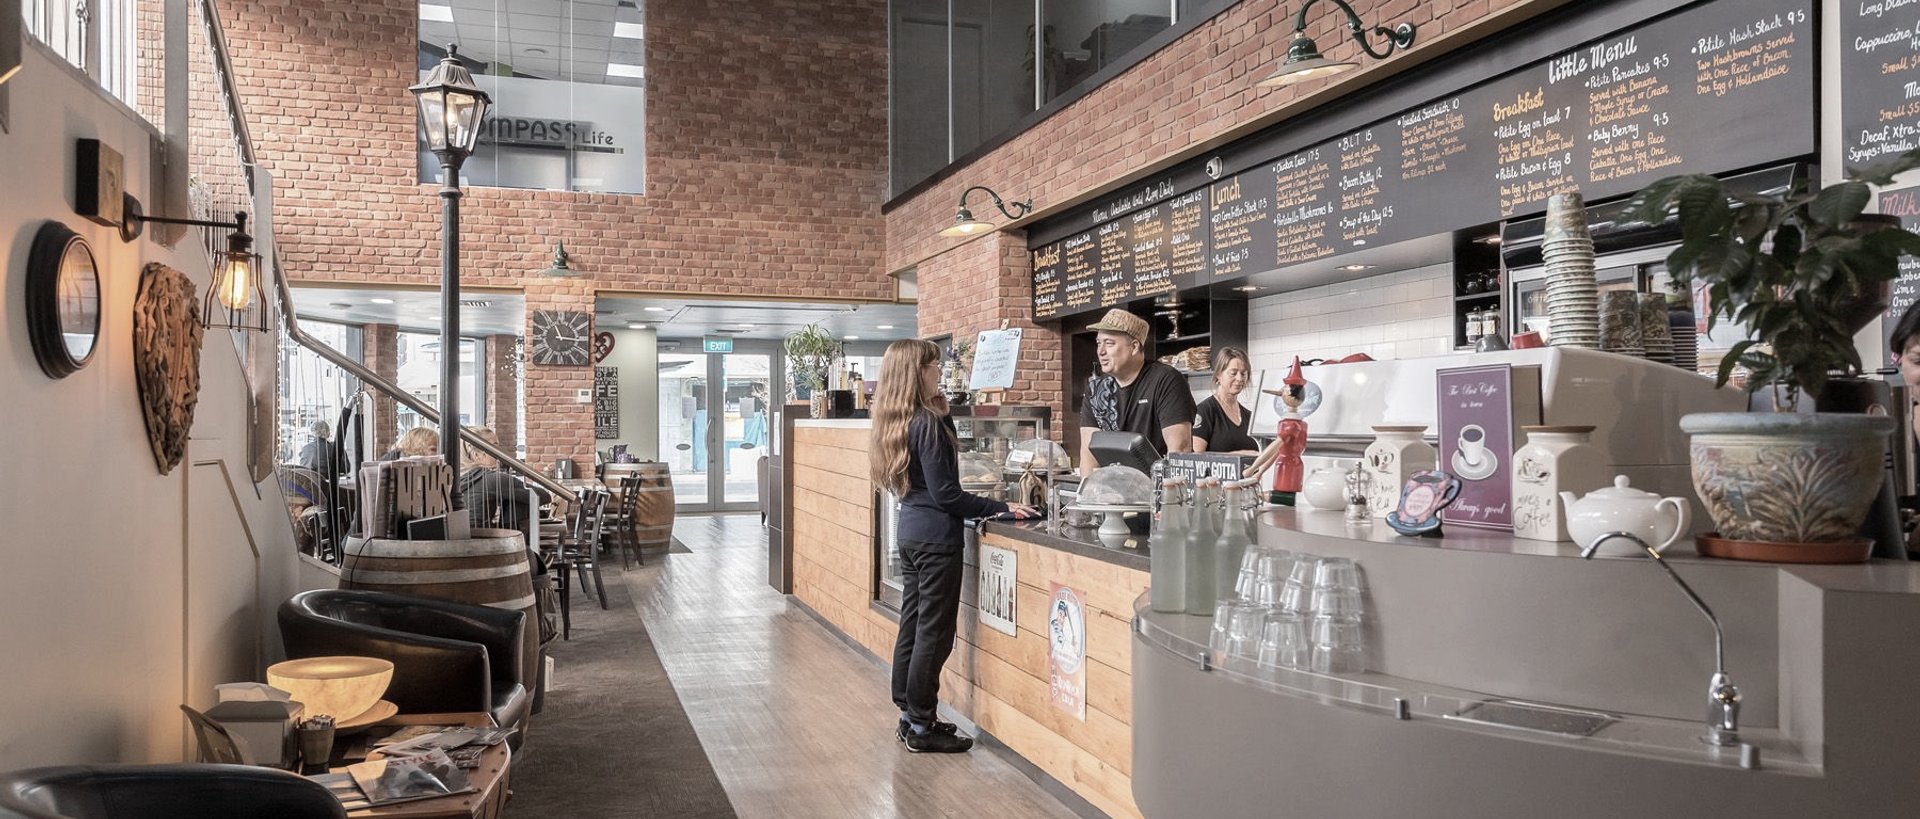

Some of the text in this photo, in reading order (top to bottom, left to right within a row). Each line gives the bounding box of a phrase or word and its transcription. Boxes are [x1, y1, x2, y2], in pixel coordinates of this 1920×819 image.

[1860, 2, 1883, 18] Long
[1697, 34, 1725, 55] Petite
[1729, 24, 1754, 45] Hash
[1755, 13, 1783, 36] Stack
[1590, 73, 1610, 89] Petite
[1612, 61, 1650, 82] Pancakes
[1696, 60, 1710, 70] Two
[1714, 69, 1729, 79] One
[1731, 62, 1750, 75] Piece
[1752, 56, 1761, 67] of
[1881, 56, 1909, 74] Small
[1589, 76, 1657, 104] Served with Banana
[1697, 85, 1710, 95] One
[1713, 80, 1726, 96] Egg
[1735, 64, 1789, 87] Hollandaise
[1401, 97, 1460, 128] Toasted Sandwich 10
[1493, 86, 1544, 122] Breakfast
[1594, 102, 1615, 114] Maple
[1616, 95, 1636, 112] Syrup
[1594, 104, 1650, 124] Chocolate Sauce
[1879, 104, 1906, 122] Small
[478, 115, 614, 145] OMPASS Life
[1499, 124, 1517, 139] Petite
[1518, 120, 1531, 138] Egg
[1532, 120, 1541, 129] on
[1564, 106, 1571, 119] 7
[1365, 129, 1372, 141] 15
[1593, 128, 1610, 144] Baby
[1612, 123, 1639, 139] Benny
[1510, 140, 1521, 155] Egg
[1591, 144, 1613, 158] Served
[1614, 139, 1629, 153] with
[1647, 132, 1666, 145] Piece
[1620, 147, 1666, 163] One One
[1848, 146, 1880, 163] Syrups:
[1500, 166, 1519, 180] Petite
[1520, 162, 1541, 176] Bacon
[1548, 157, 1562, 176] Egg
[1564, 152, 1571, 165] 8
[1590, 155, 1682, 182] Piece of Hollandaise
[1342, 175, 1359, 191] Bacon
[1359, 170, 1374, 188] Butty
[1375, 167, 1383, 180] 12
[1211, 176, 1241, 211] Lunch
[1343, 216, 1357, 229] Soup
[1357, 212, 1362, 224] of
[1362, 212, 1370, 222] the
[1371, 209, 1382, 226] Day
[1034, 243, 1060, 271] Breakfast
[1893, 284, 1915, 295] ime
[710, 341, 726, 351] EXIT
[596, 385, 617, 397] FE
[597, 417, 617, 426] ILE
[1211, 461, 1237, 480] GOTTA
[1484, 502, 1506, 520] good
